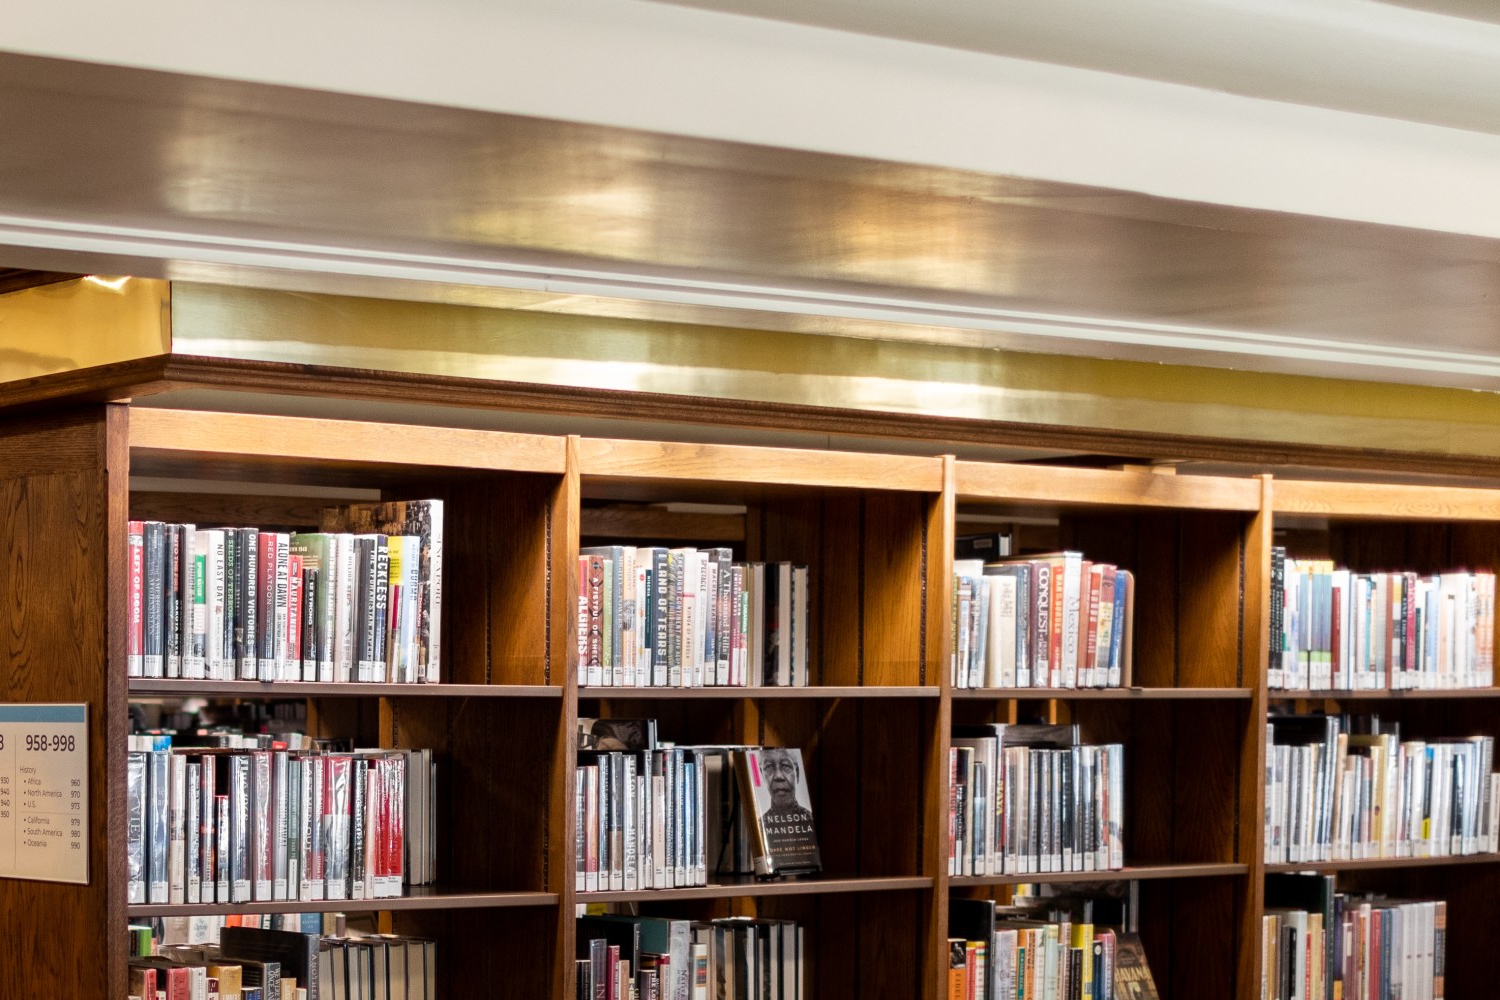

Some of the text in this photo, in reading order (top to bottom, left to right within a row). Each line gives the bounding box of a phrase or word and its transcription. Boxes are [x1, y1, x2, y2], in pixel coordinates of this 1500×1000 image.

[217, 544, 223, 555] NO
[248, 534, 256, 551] ONE
[134, 576, 140, 590] OF
[228, 569, 233, 580] OF
[248, 555, 256, 596] HUNDRED
[277, 543, 288, 607] ALONE AT DAWN
[376, 546, 388, 609] RECKLESS
[724, 570, 730, 578] A
[289, 577, 298, 644] MAURITANIAN
[658, 599, 666, 612] OF
[723, 582, 731, 626] Thousand
[1038, 568, 1049, 635] CONQUEST
[579, 596, 587, 654] ALGIERS
[658, 618, 666, 656] TEARS
[1067, 596, 1079, 653] Mexico
[26, 735, 75, 751] 958-998
[766, 825, 813, 834] MANDELA
[767, 814, 807, 823] NELSON
